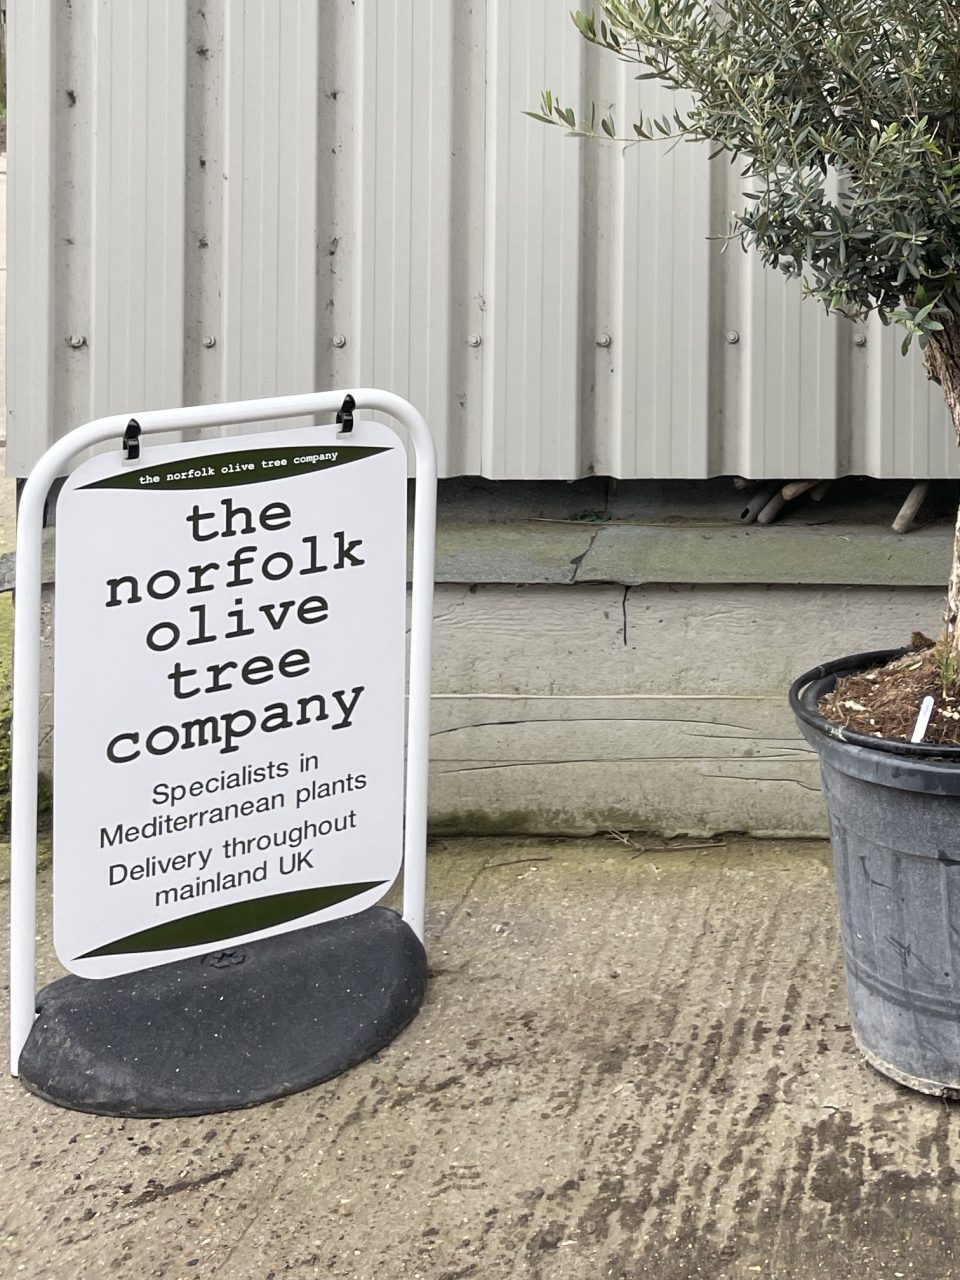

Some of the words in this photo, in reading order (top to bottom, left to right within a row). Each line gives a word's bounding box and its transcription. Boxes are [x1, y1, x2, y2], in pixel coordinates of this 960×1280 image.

[139, 474, 160, 486] the
[166, 467, 216, 481] norfolk
[221, 463, 255, 474] olive
[261, 458, 288, 469] tree
[293, 451, 339, 465] company
[185, 497, 292, 542] the
[105, 530, 366, 608] norfolk
[146, 595, 329, 652] olive
[167, 648, 310, 700] tree
[106, 685, 365, 764] company
[152, 762, 289, 807] Specialists
[300, 753, 319, 773] in
[100, 794, 285, 849] Mediterranean
[296, 773, 367, 809] plants
[109, 848, 213, 886] Delivery
[222, 809, 357, 859] throughout
[155, 860, 267, 907] mainland
[279, 848, 314, 875] UK
